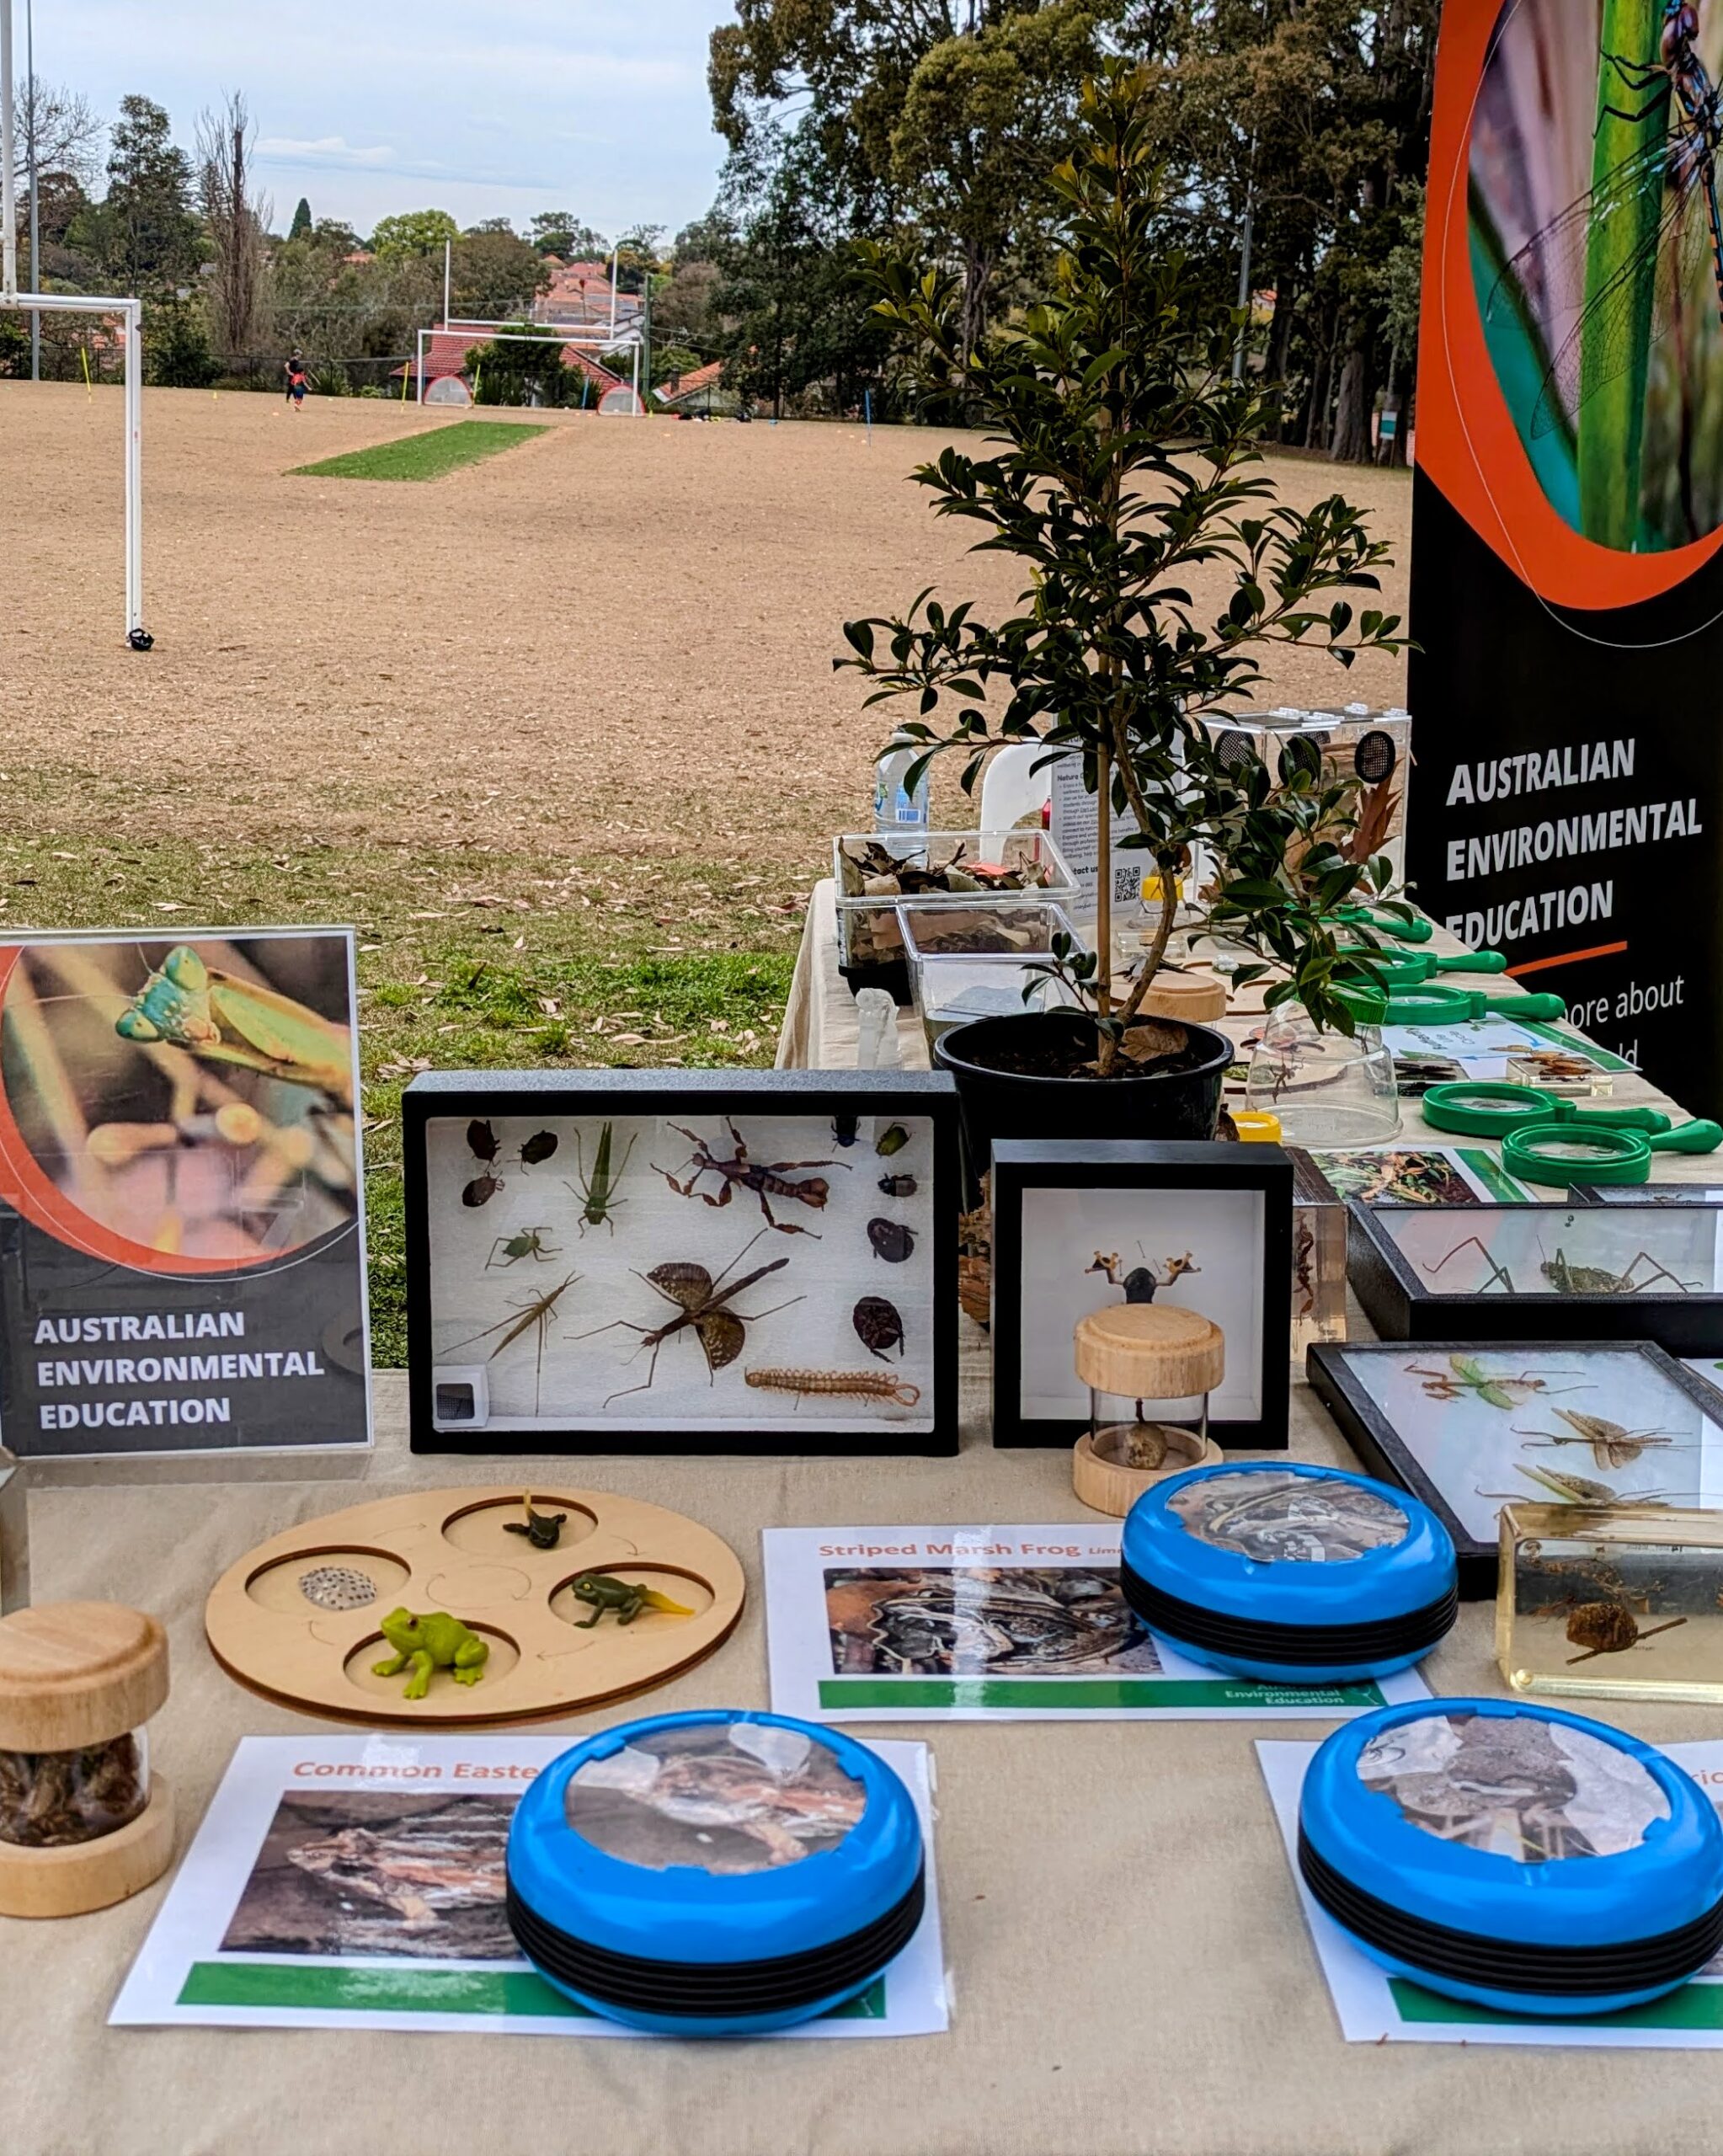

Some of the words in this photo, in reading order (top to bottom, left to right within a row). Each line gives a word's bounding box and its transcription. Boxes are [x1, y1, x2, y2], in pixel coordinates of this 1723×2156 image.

[1446, 738, 1635, 806] AUSTRALIAN
[1446, 798, 1702, 882] ENVIRONMENTAL
[1073, 866, 1089, 875] tact
[1564, 999, 1608, 1029] ore
[1615, 975, 1684, 1018] about
[35, 1311, 245, 1345] AUSTRALIAN
[37, 1351, 325, 1387] ENVIRONMENTAL
[40, 1397, 232, 1430] EDUCATION
[819, 1543, 916, 1557] Striped
[926, 1543, 1012, 1556] Marsh
[1021, 1543, 1081, 1557] Frog
[1225, 1689, 1341, 1698] Environmental
[1265, 1696, 1345, 1705] Education
[293, 1762, 442, 1778] Common
[453, 1763, 540, 1779] Easte
